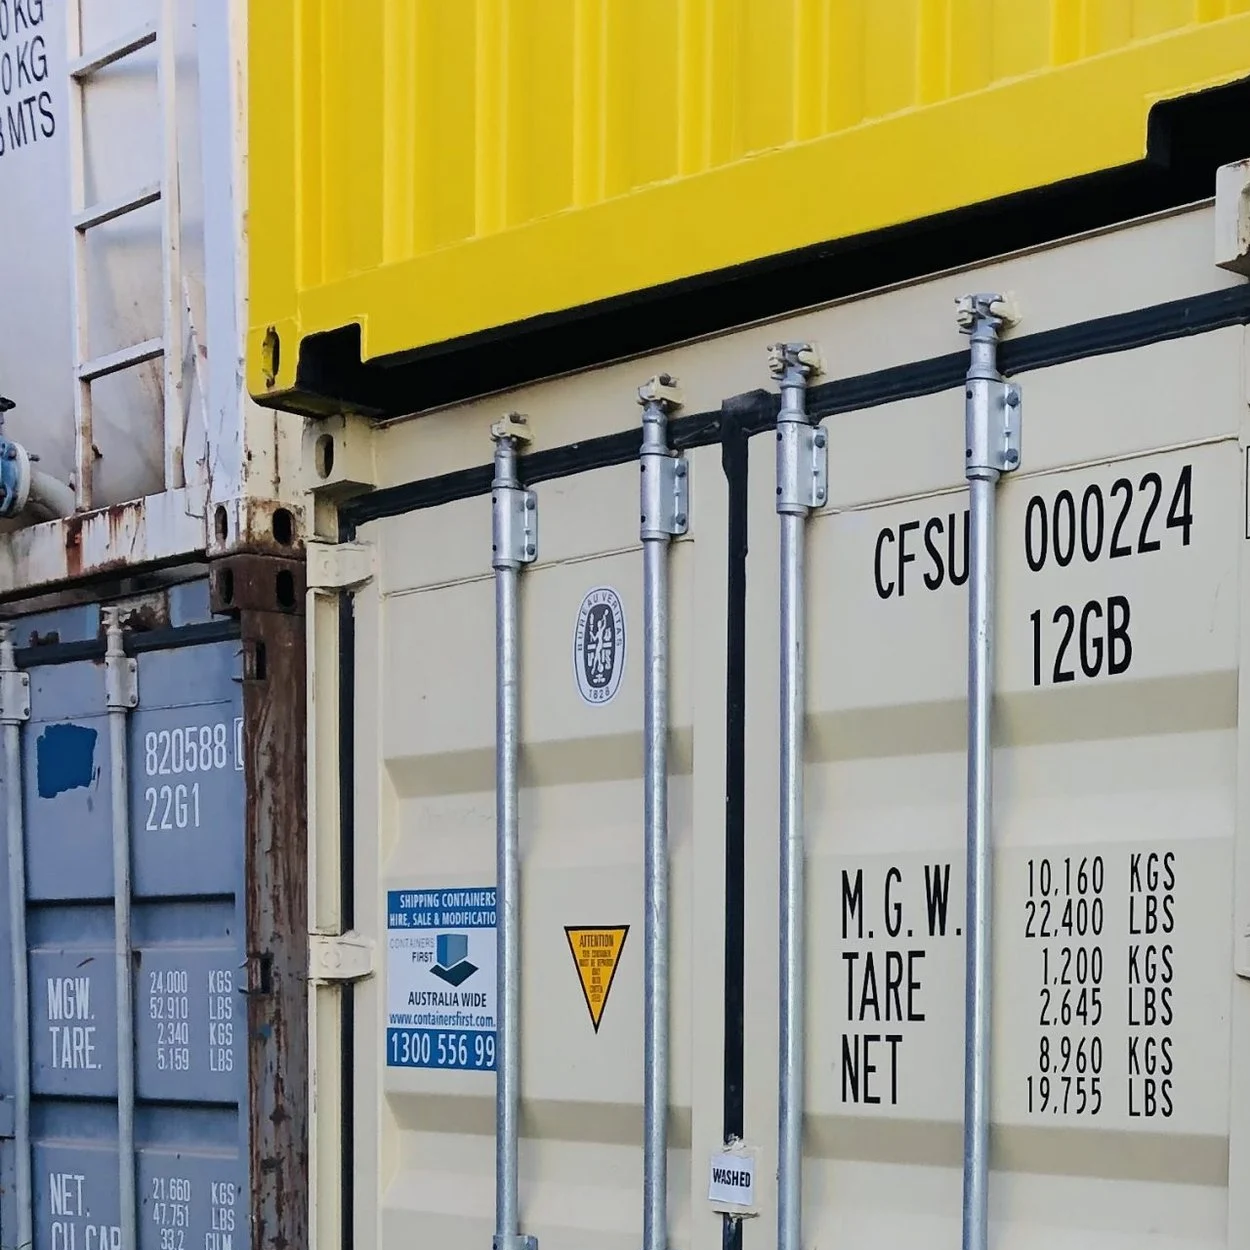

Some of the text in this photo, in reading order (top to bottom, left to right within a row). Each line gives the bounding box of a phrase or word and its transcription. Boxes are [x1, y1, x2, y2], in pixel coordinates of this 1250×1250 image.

[7, 91, 55, 151] MTS
[874, 510, 970, 599] CFSU
[1024, 465, 1194, 572] 000224
[1030, 595, 1132, 686] 12GB
[145, 723, 227, 776] 820588
[145, 782, 201, 831] 22G1
[1130, 852, 1175, 893] KGS
[389, 911, 496, 927] HIRE, SALE & MODIFICATIO
[400, 892, 496, 908] SHIPPING CONTAINERS
[1129, 895, 1175, 934] LBS
[389, 937, 435, 949] CONTAINERS
[412, 951, 433, 963] FIRST
[48, 971, 232, 1020] MGW. 24.000 KGS
[408, 992, 487, 1007] AUSTRALIA WIDE
[842, 950, 926, 1021] TARE
[1128, 944, 1173, 984] KGS
[150, 997, 233, 1020] 52.910 LBS
[389, 1010, 496, 1027] www.containersfirst.com.
[1128, 987, 1173, 1026] LBS
[50, 1023, 233, 1070] TARE. 2.340 KGS
[210, 1050, 233, 1072] LBS
[392, 1032, 495, 1067] 1300 556 99
[842, 1034, 903, 1104] NET
[1128, 1036, 1173, 1075] KGS
[1128, 1078, 1173, 1117] LBS
[50, 1173, 90, 1217] NET.
[211, 1182, 235, 1206] KGS
[713, 1168, 751, 1188] WASHED
[212, 1208, 235, 1231] LBS
